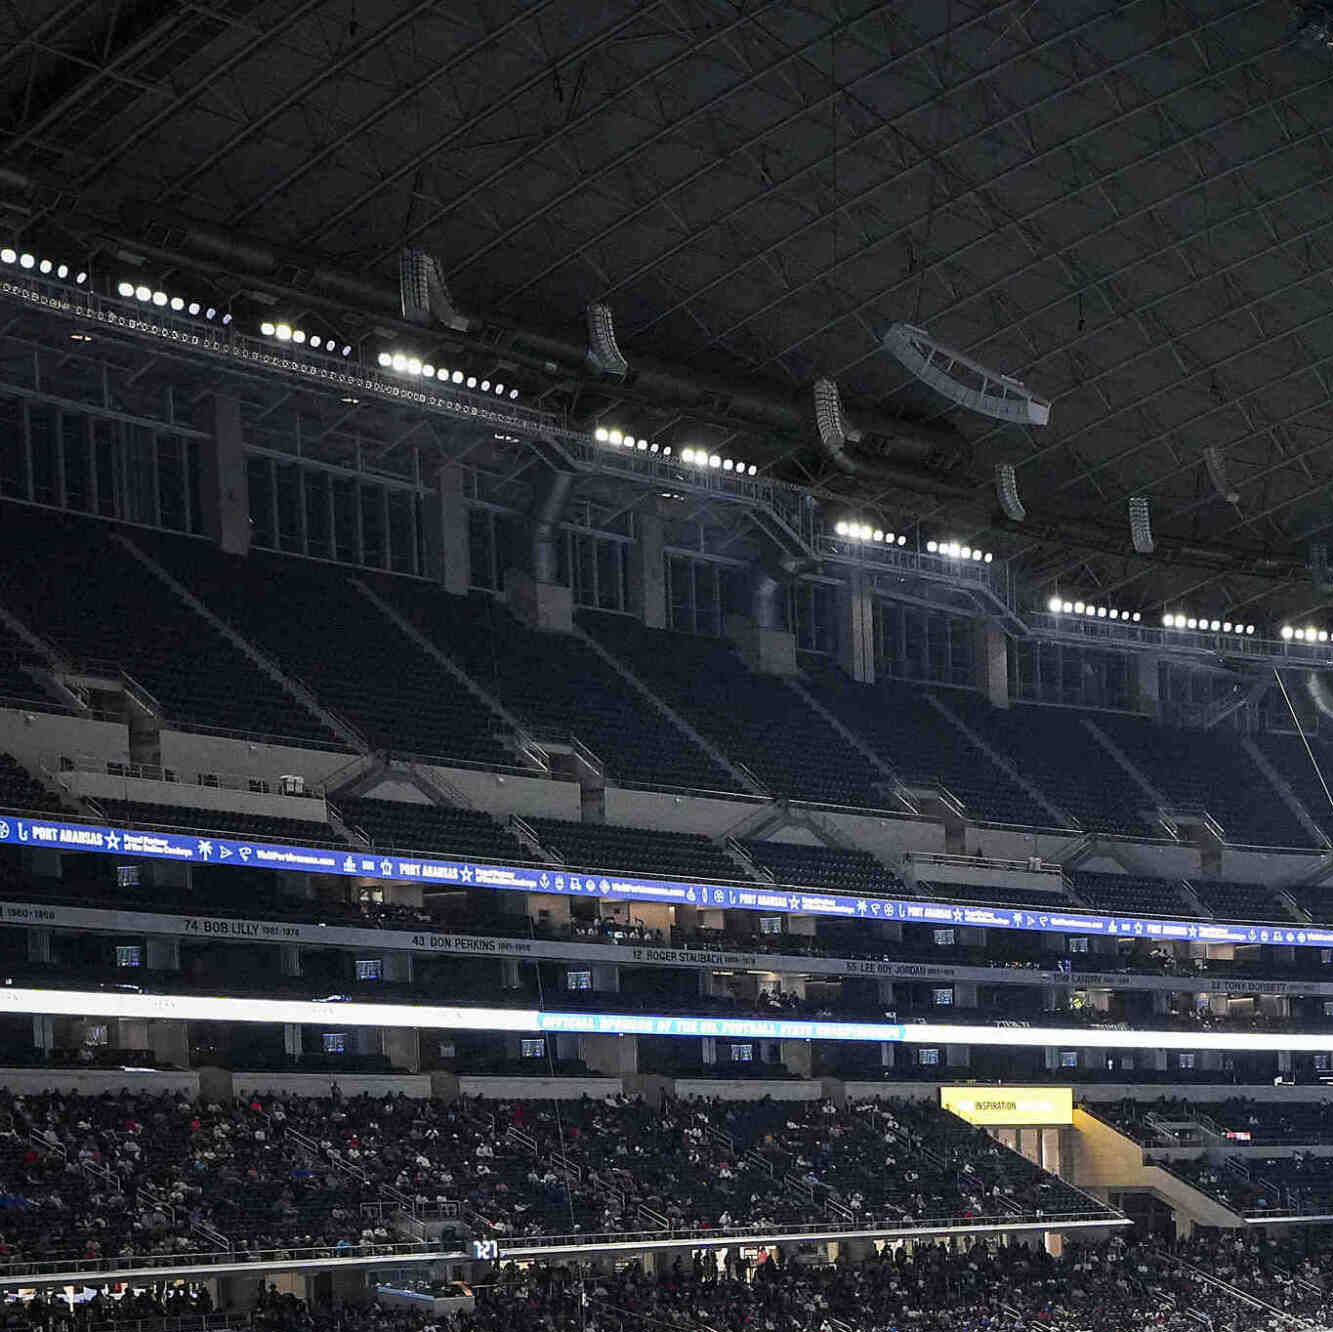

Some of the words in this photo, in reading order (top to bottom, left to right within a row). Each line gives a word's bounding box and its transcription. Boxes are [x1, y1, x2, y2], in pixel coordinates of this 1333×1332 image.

[32, 826, 58, 843] PORT
[184, 918, 198, 932] 74
[203, 921, 229, 934] BOB
[231, 921, 260, 937] LILLY
[429, 937, 452, 949] DON
[454, 939, 496, 952] PERKINS
[975, 1100, 1017, 1112] INSPIRATION
